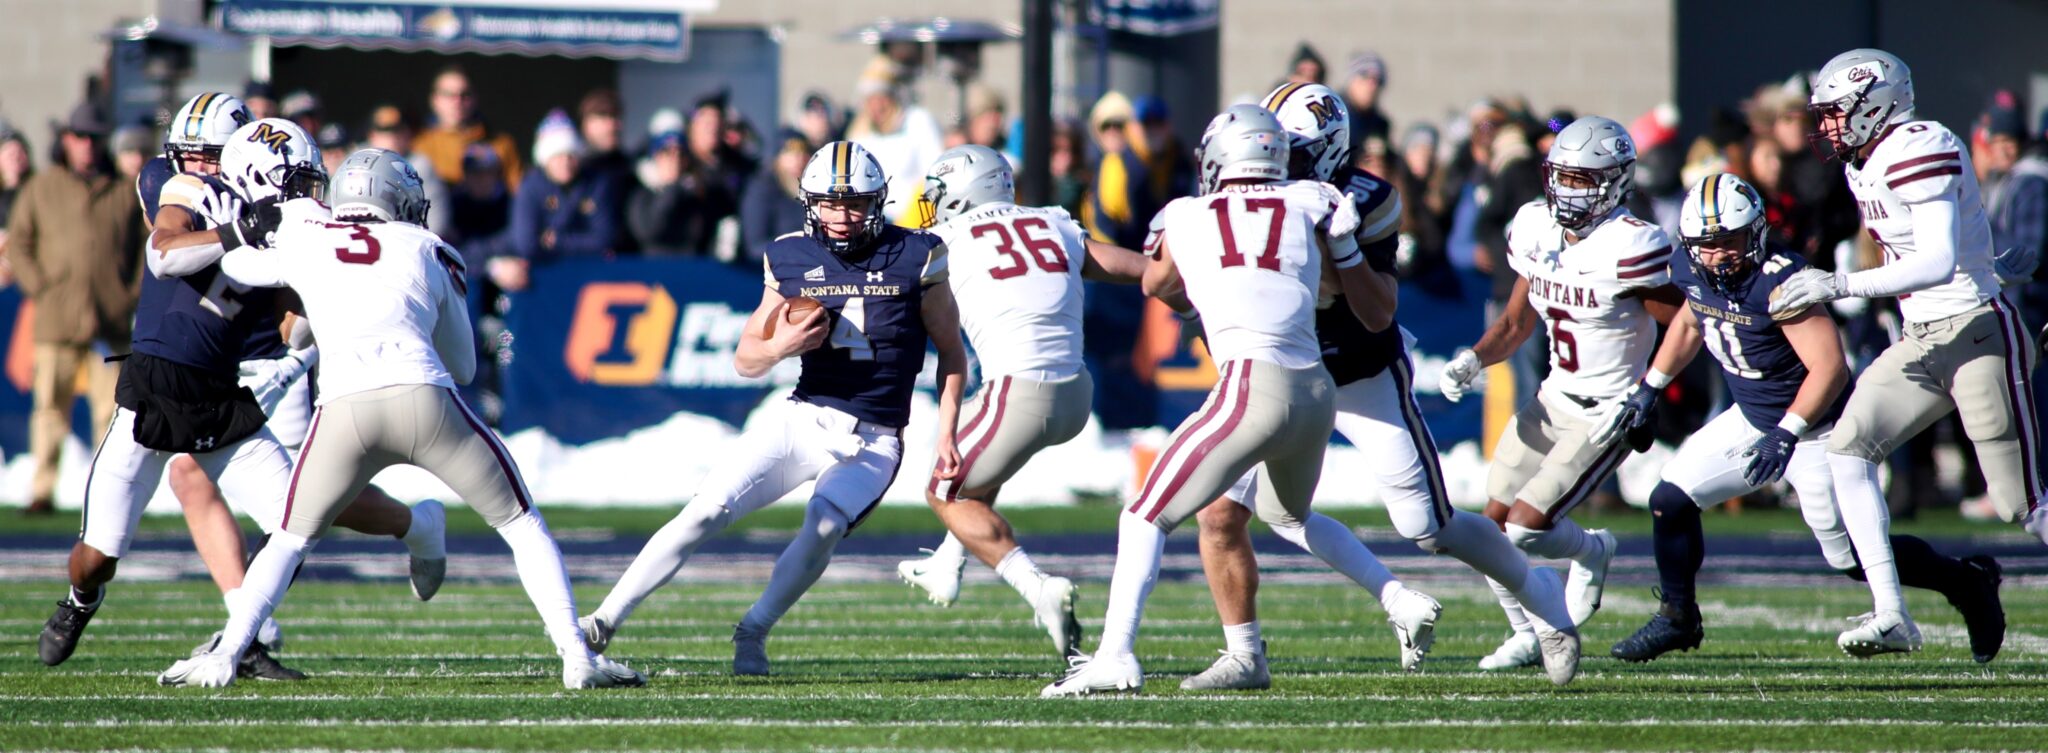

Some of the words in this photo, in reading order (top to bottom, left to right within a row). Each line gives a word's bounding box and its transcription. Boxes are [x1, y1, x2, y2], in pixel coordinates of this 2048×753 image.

[1306, 95, 1343, 130] M
[247, 123, 292, 154] M
[325, 223, 381, 265] 3
[970, 217, 1069, 280] 36
[1209, 198, 1286, 271] 17
[800, 284, 860, 297] MONTANA
[863, 285, 900, 296] STATE
[1528, 271, 1599, 308] MONTANA
[830, 297, 874, 360] 4
[1724, 311, 1752, 325] STATE
[1546, 306, 1579, 373] 6
